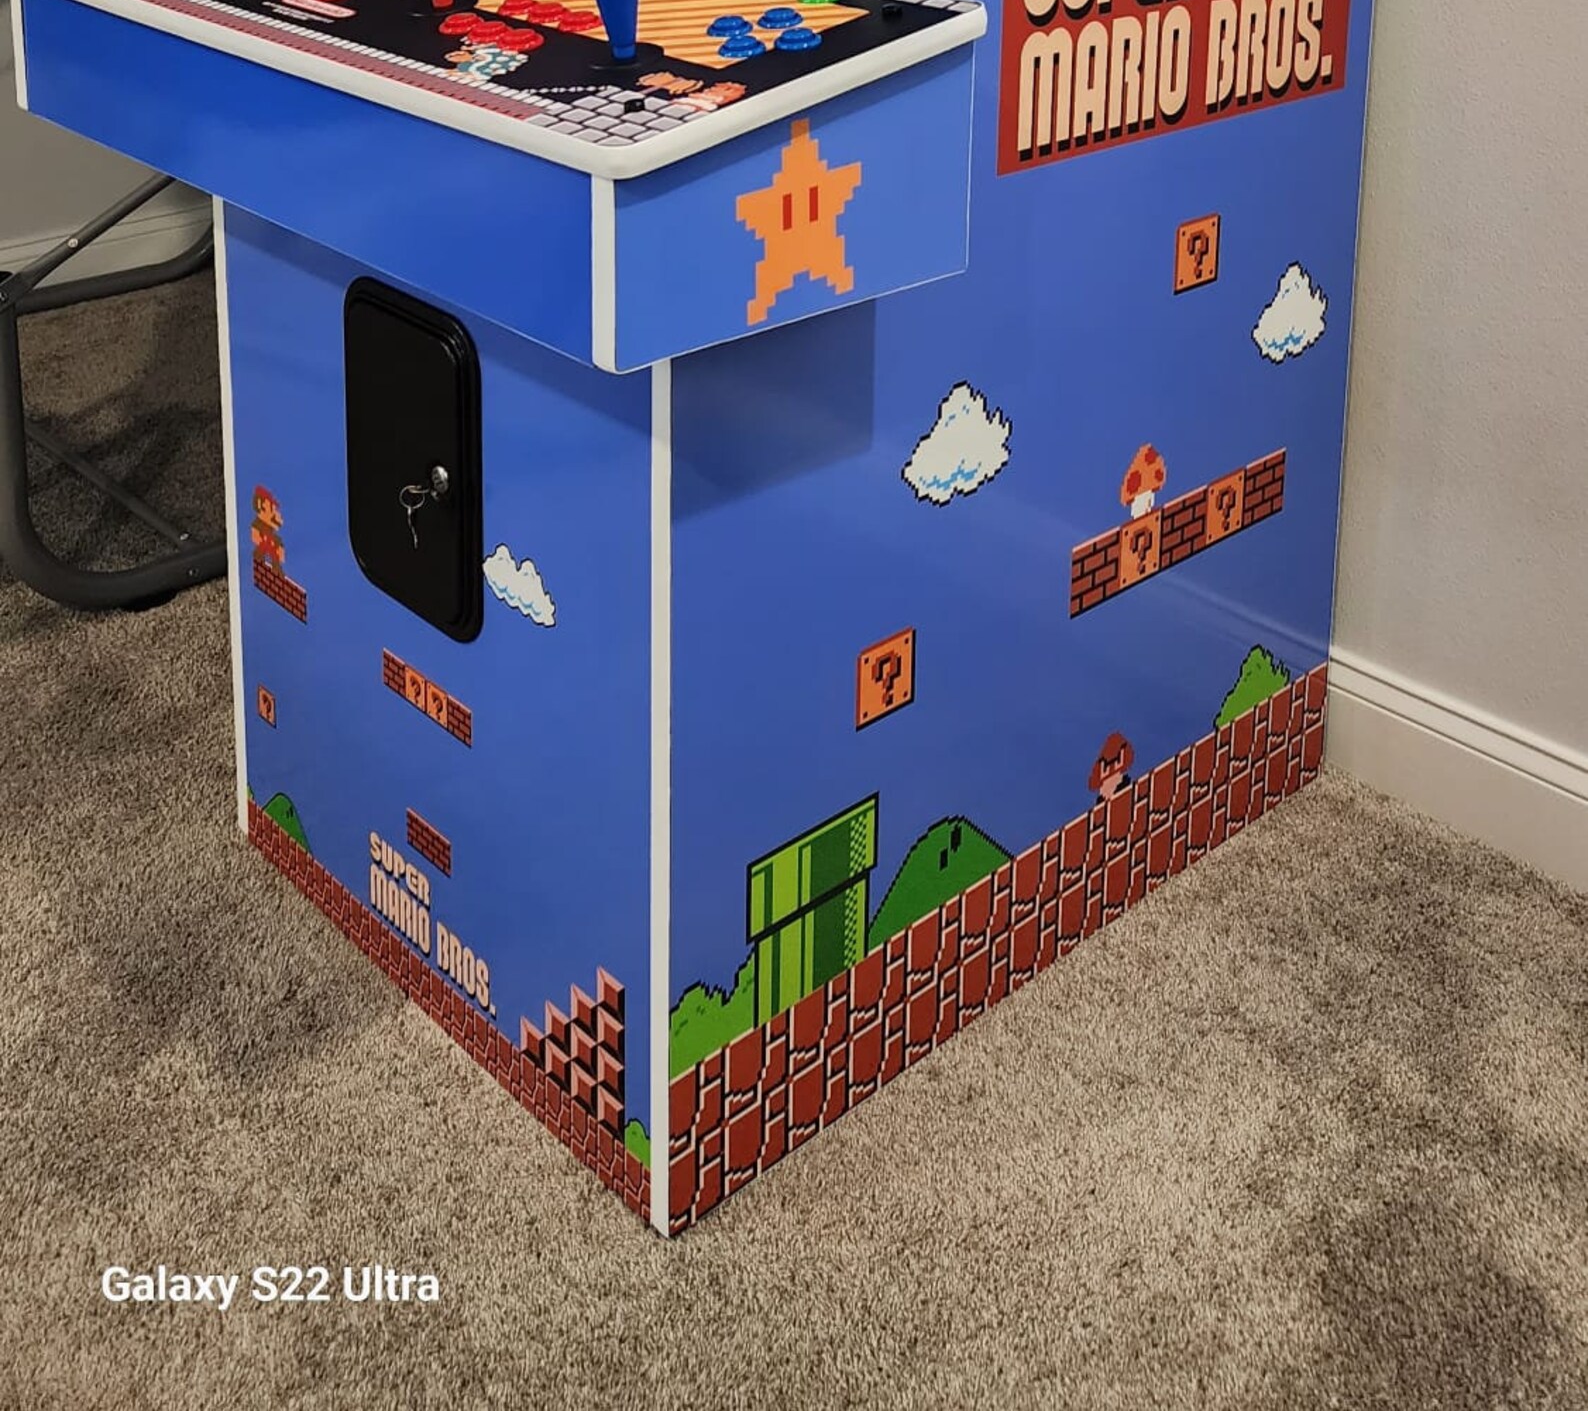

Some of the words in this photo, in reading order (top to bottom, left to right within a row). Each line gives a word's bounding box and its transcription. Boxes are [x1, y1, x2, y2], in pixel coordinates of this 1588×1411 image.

[1017, 4, 1193, 163] MARIO
[369, 830, 431, 910] SUPER
[369, 863, 432, 958] MARIO
[436, 920, 497, 1021] BROS.
